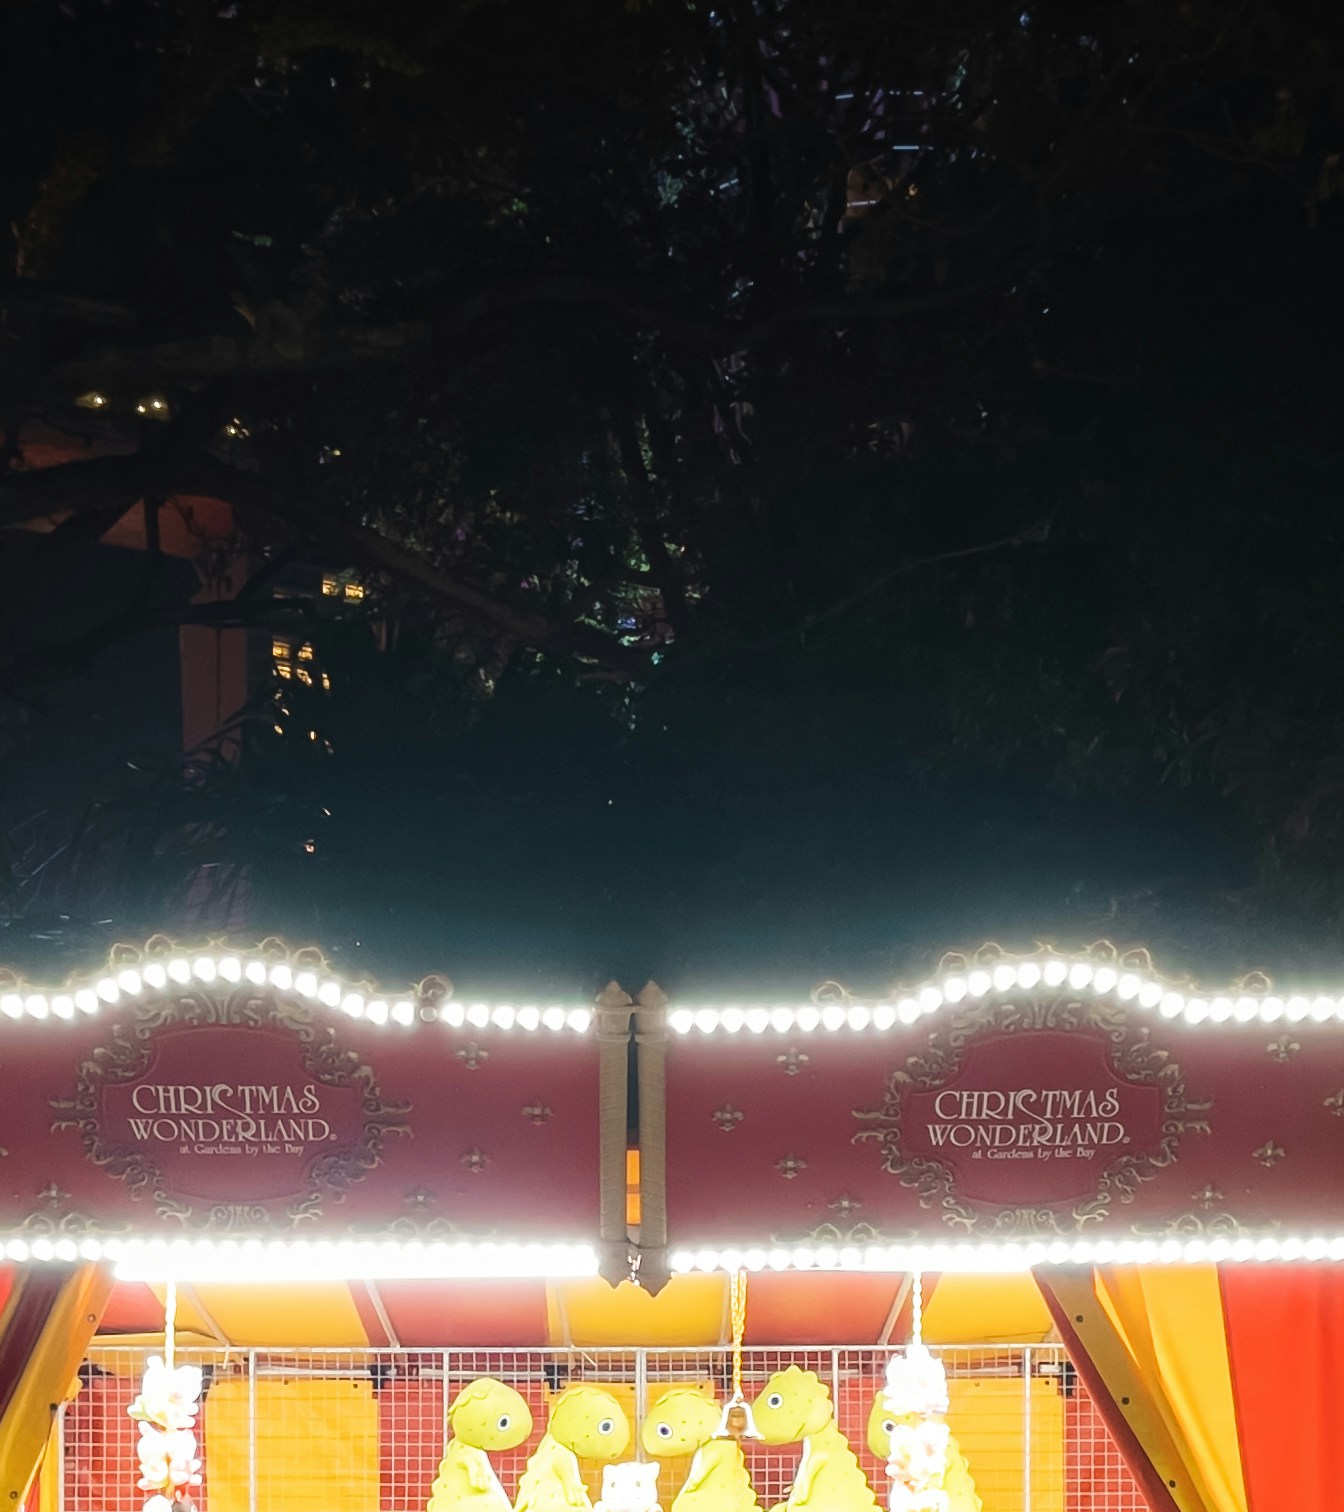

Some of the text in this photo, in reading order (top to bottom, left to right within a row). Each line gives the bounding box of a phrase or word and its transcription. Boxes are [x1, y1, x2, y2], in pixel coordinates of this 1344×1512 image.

[132, 1083, 320, 1115] CHRISTMAS
[934, 1088, 1120, 1120] CHRISTMAS
[245, 1143, 259, 1156] by
[262, 1143, 281, 1154] the
[971, 1146, 1096, 1161] at Gardens by the Bay
